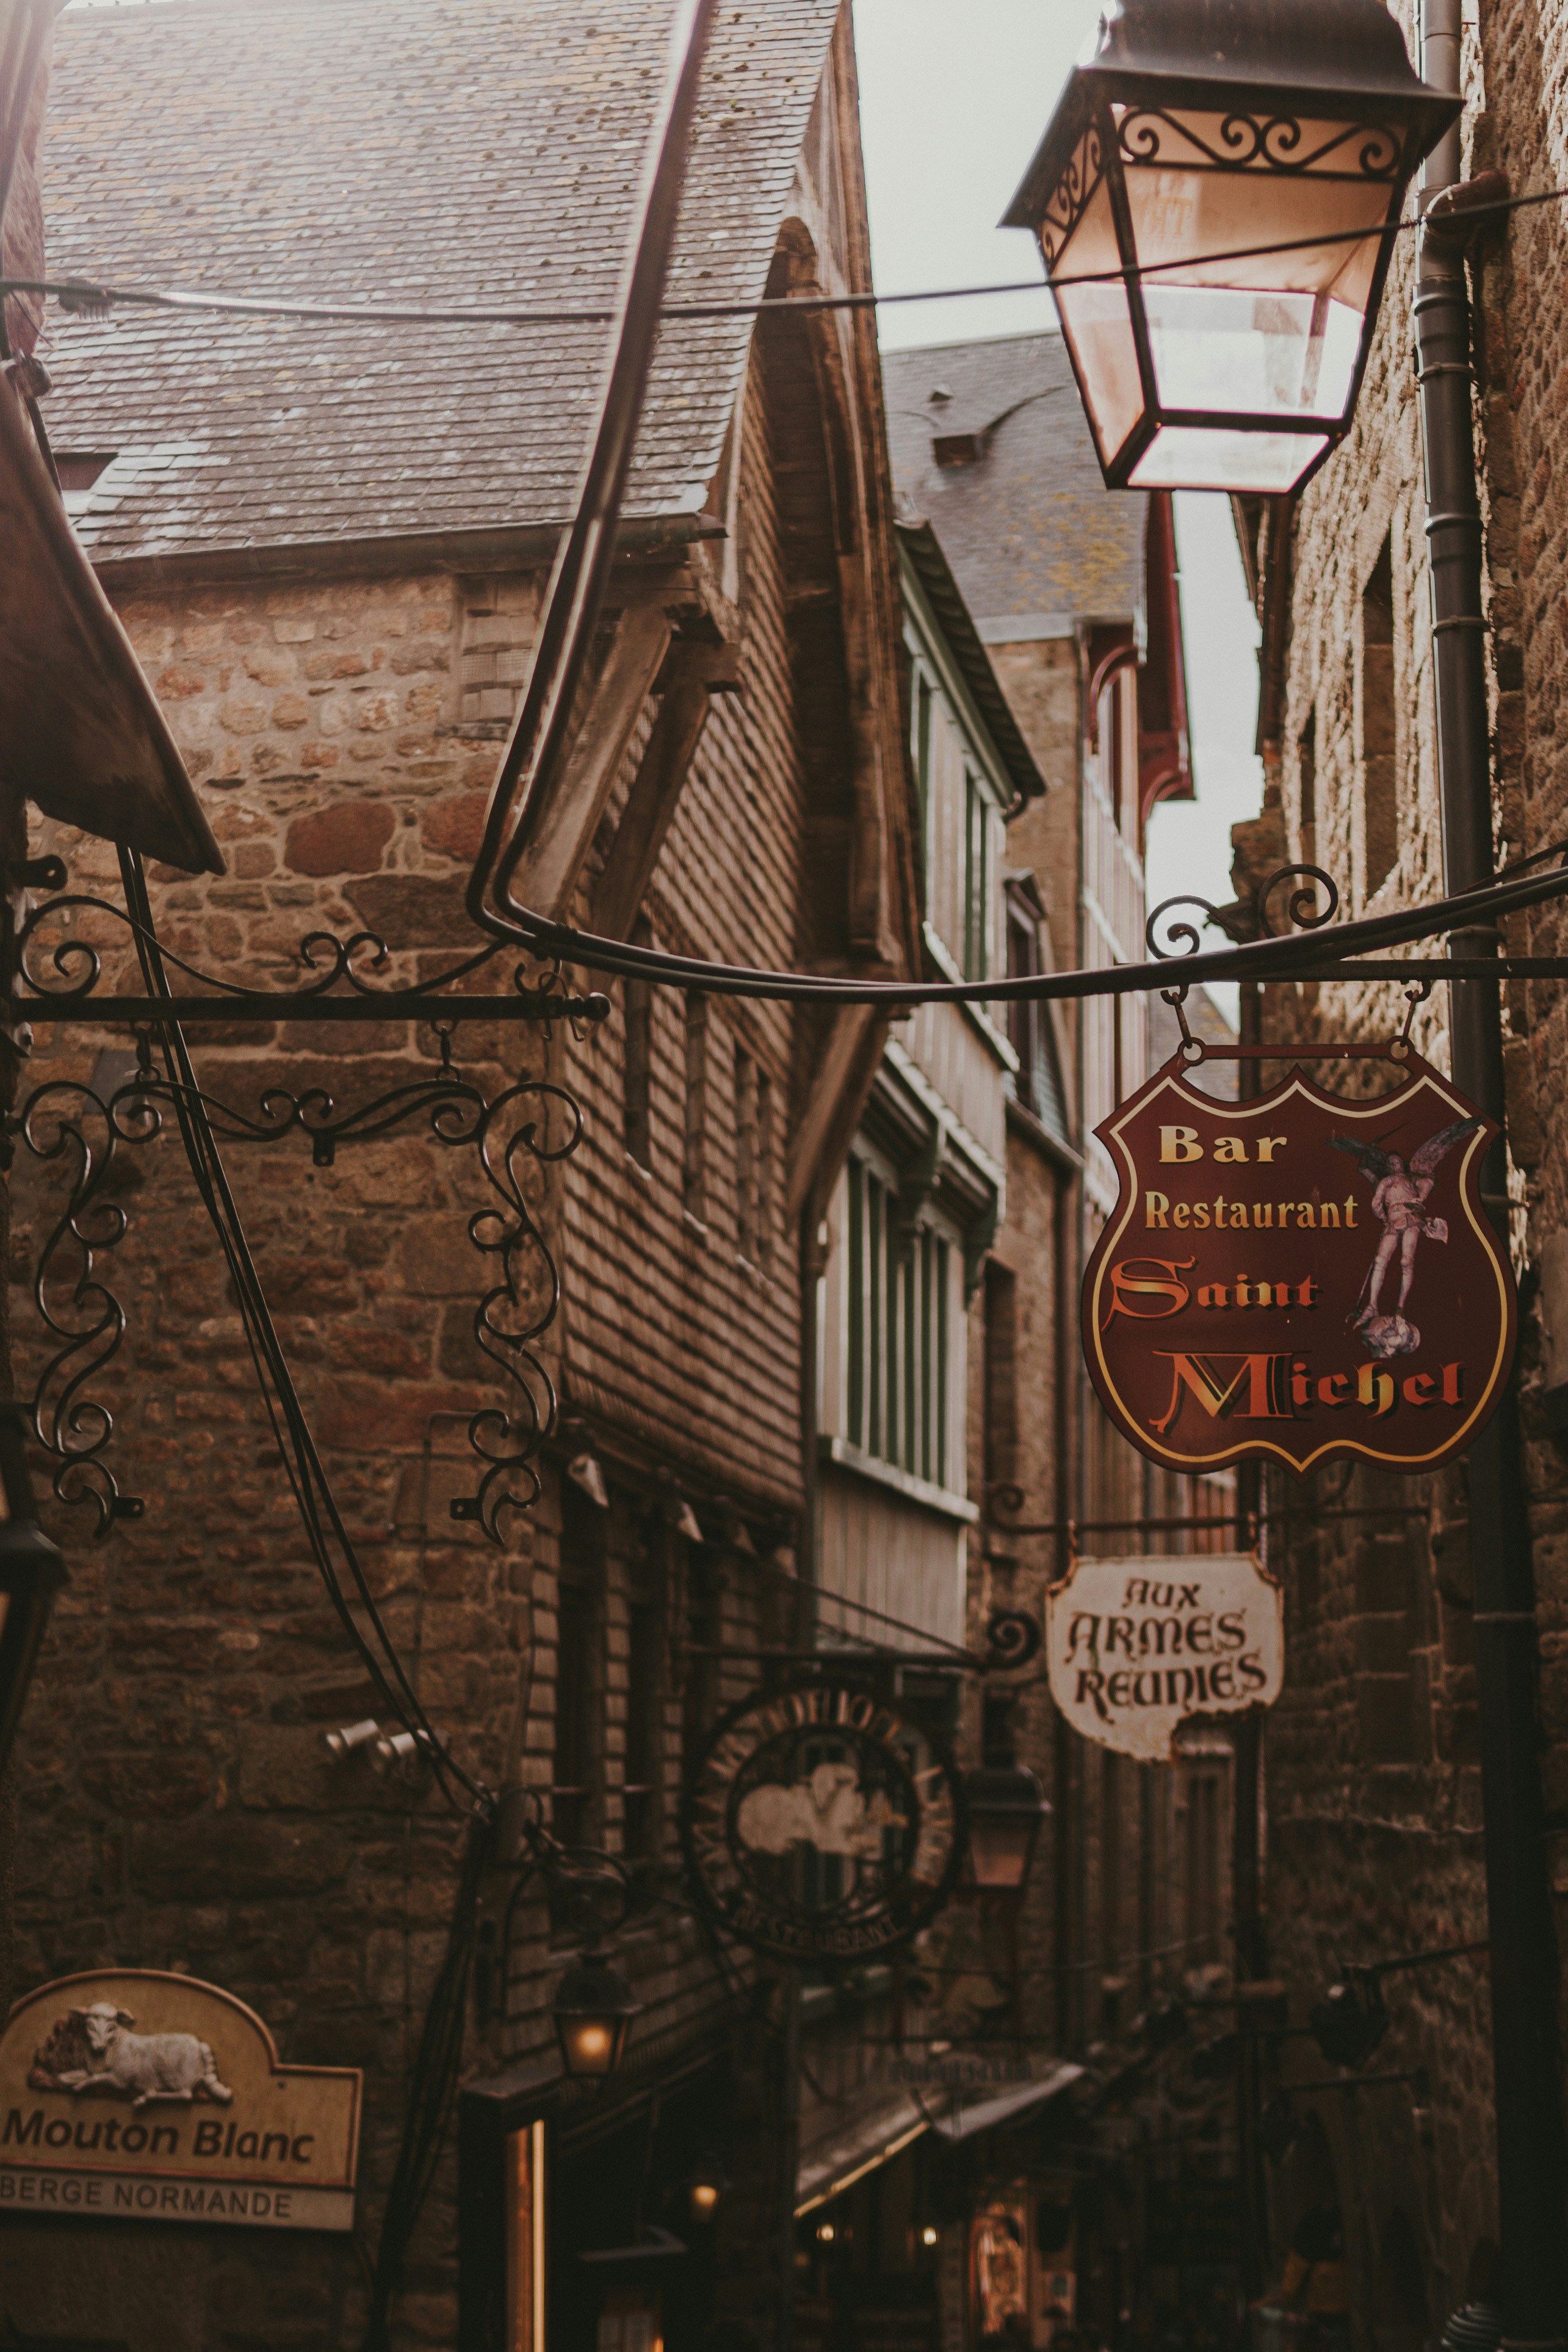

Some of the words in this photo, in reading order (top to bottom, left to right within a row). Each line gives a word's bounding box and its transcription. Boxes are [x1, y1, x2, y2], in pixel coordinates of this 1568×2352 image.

[1158, 1125, 1288, 1163] Bar
[1145, 1191, 1359, 1229] Restaurant
[1101, 1256, 1319, 1333] Saint
[1149, 1350, 1466, 1433] Michel
[1122, 1578, 1201, 1613] AUX
[1064, 1609, 1246, 1664] ARMES
[1075, 1648, 1267, 1724] REUNIES
[2, 2108, 179, 2154] Mouton
[193, 2120, 315, 2163] Blanc
[0, 2175, 102, 2205] BERGE
[115, 2184, 292, 2218] NORMANDE
